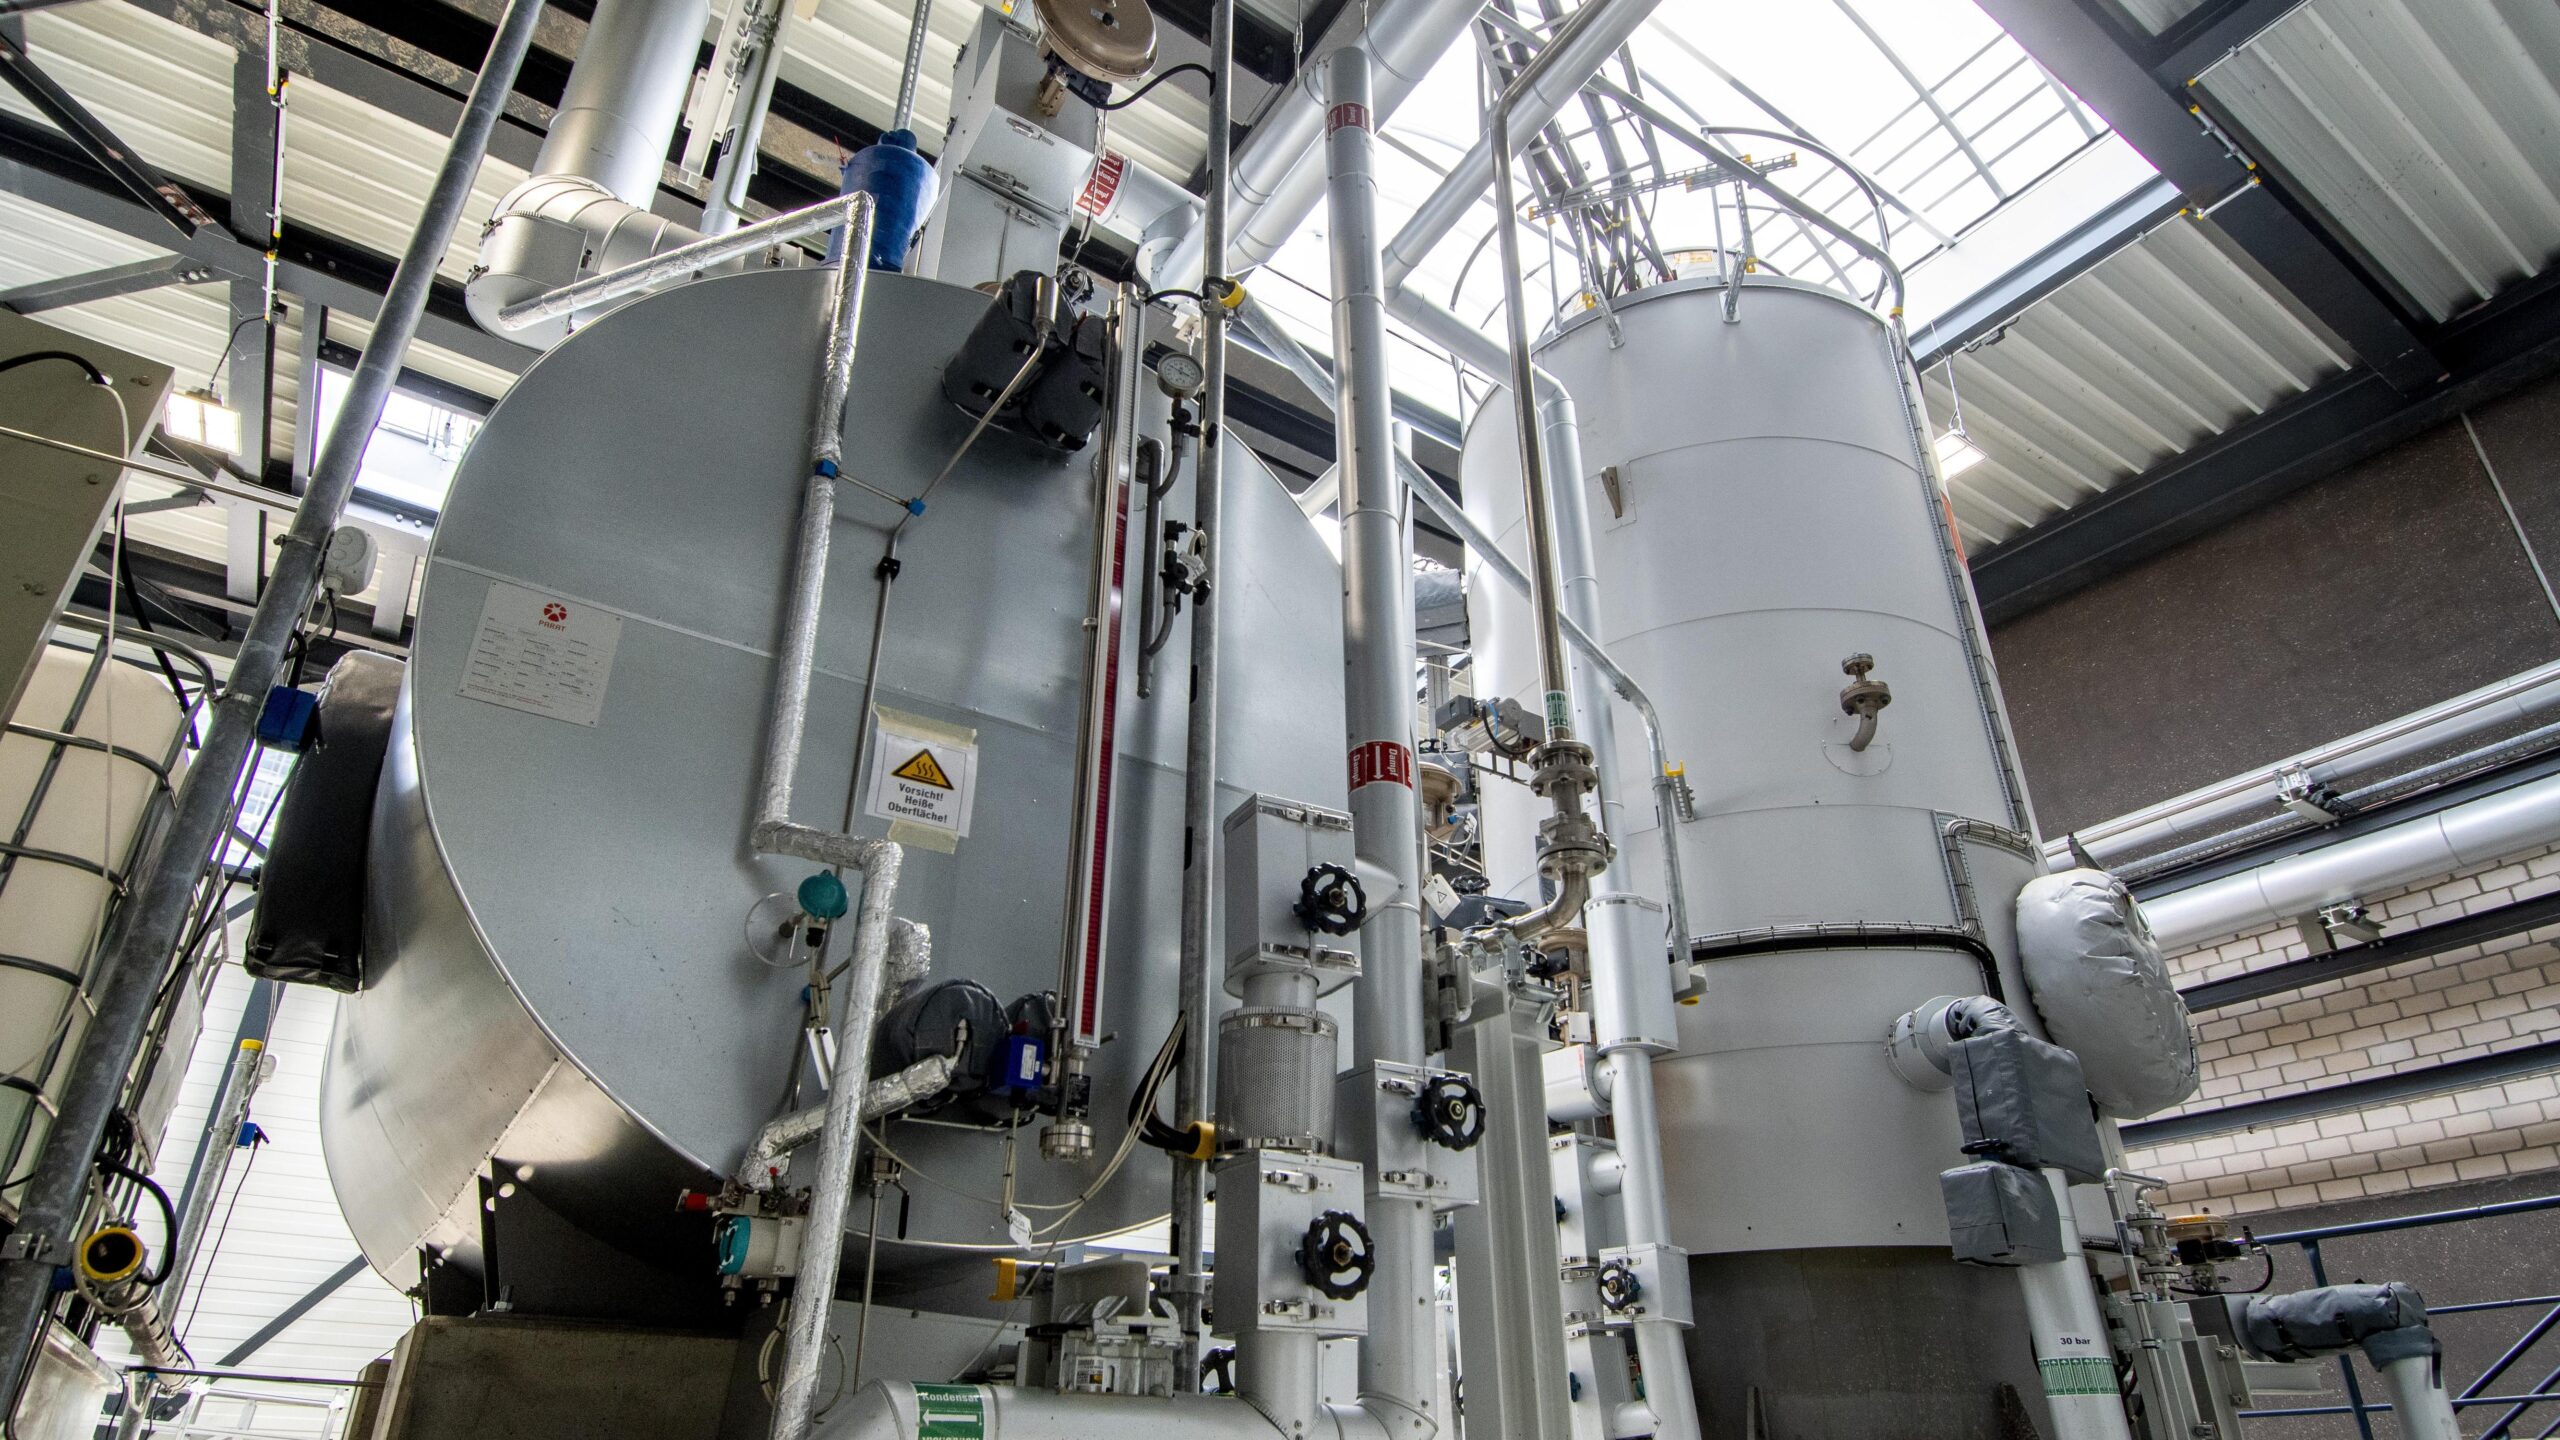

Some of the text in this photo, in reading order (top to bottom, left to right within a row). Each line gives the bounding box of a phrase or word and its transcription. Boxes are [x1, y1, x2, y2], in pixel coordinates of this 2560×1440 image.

[538, 619, 567, 632] PARAT
[1387, 748, 1399, 777] Dampf
[899, 783, 944, 801] Vorsicht!
[904, 795, 934, 810] Heiße
[888, 801, 948, 824] Oberfläche!
[2060, 1337, 2091, 1345] 30 bar
